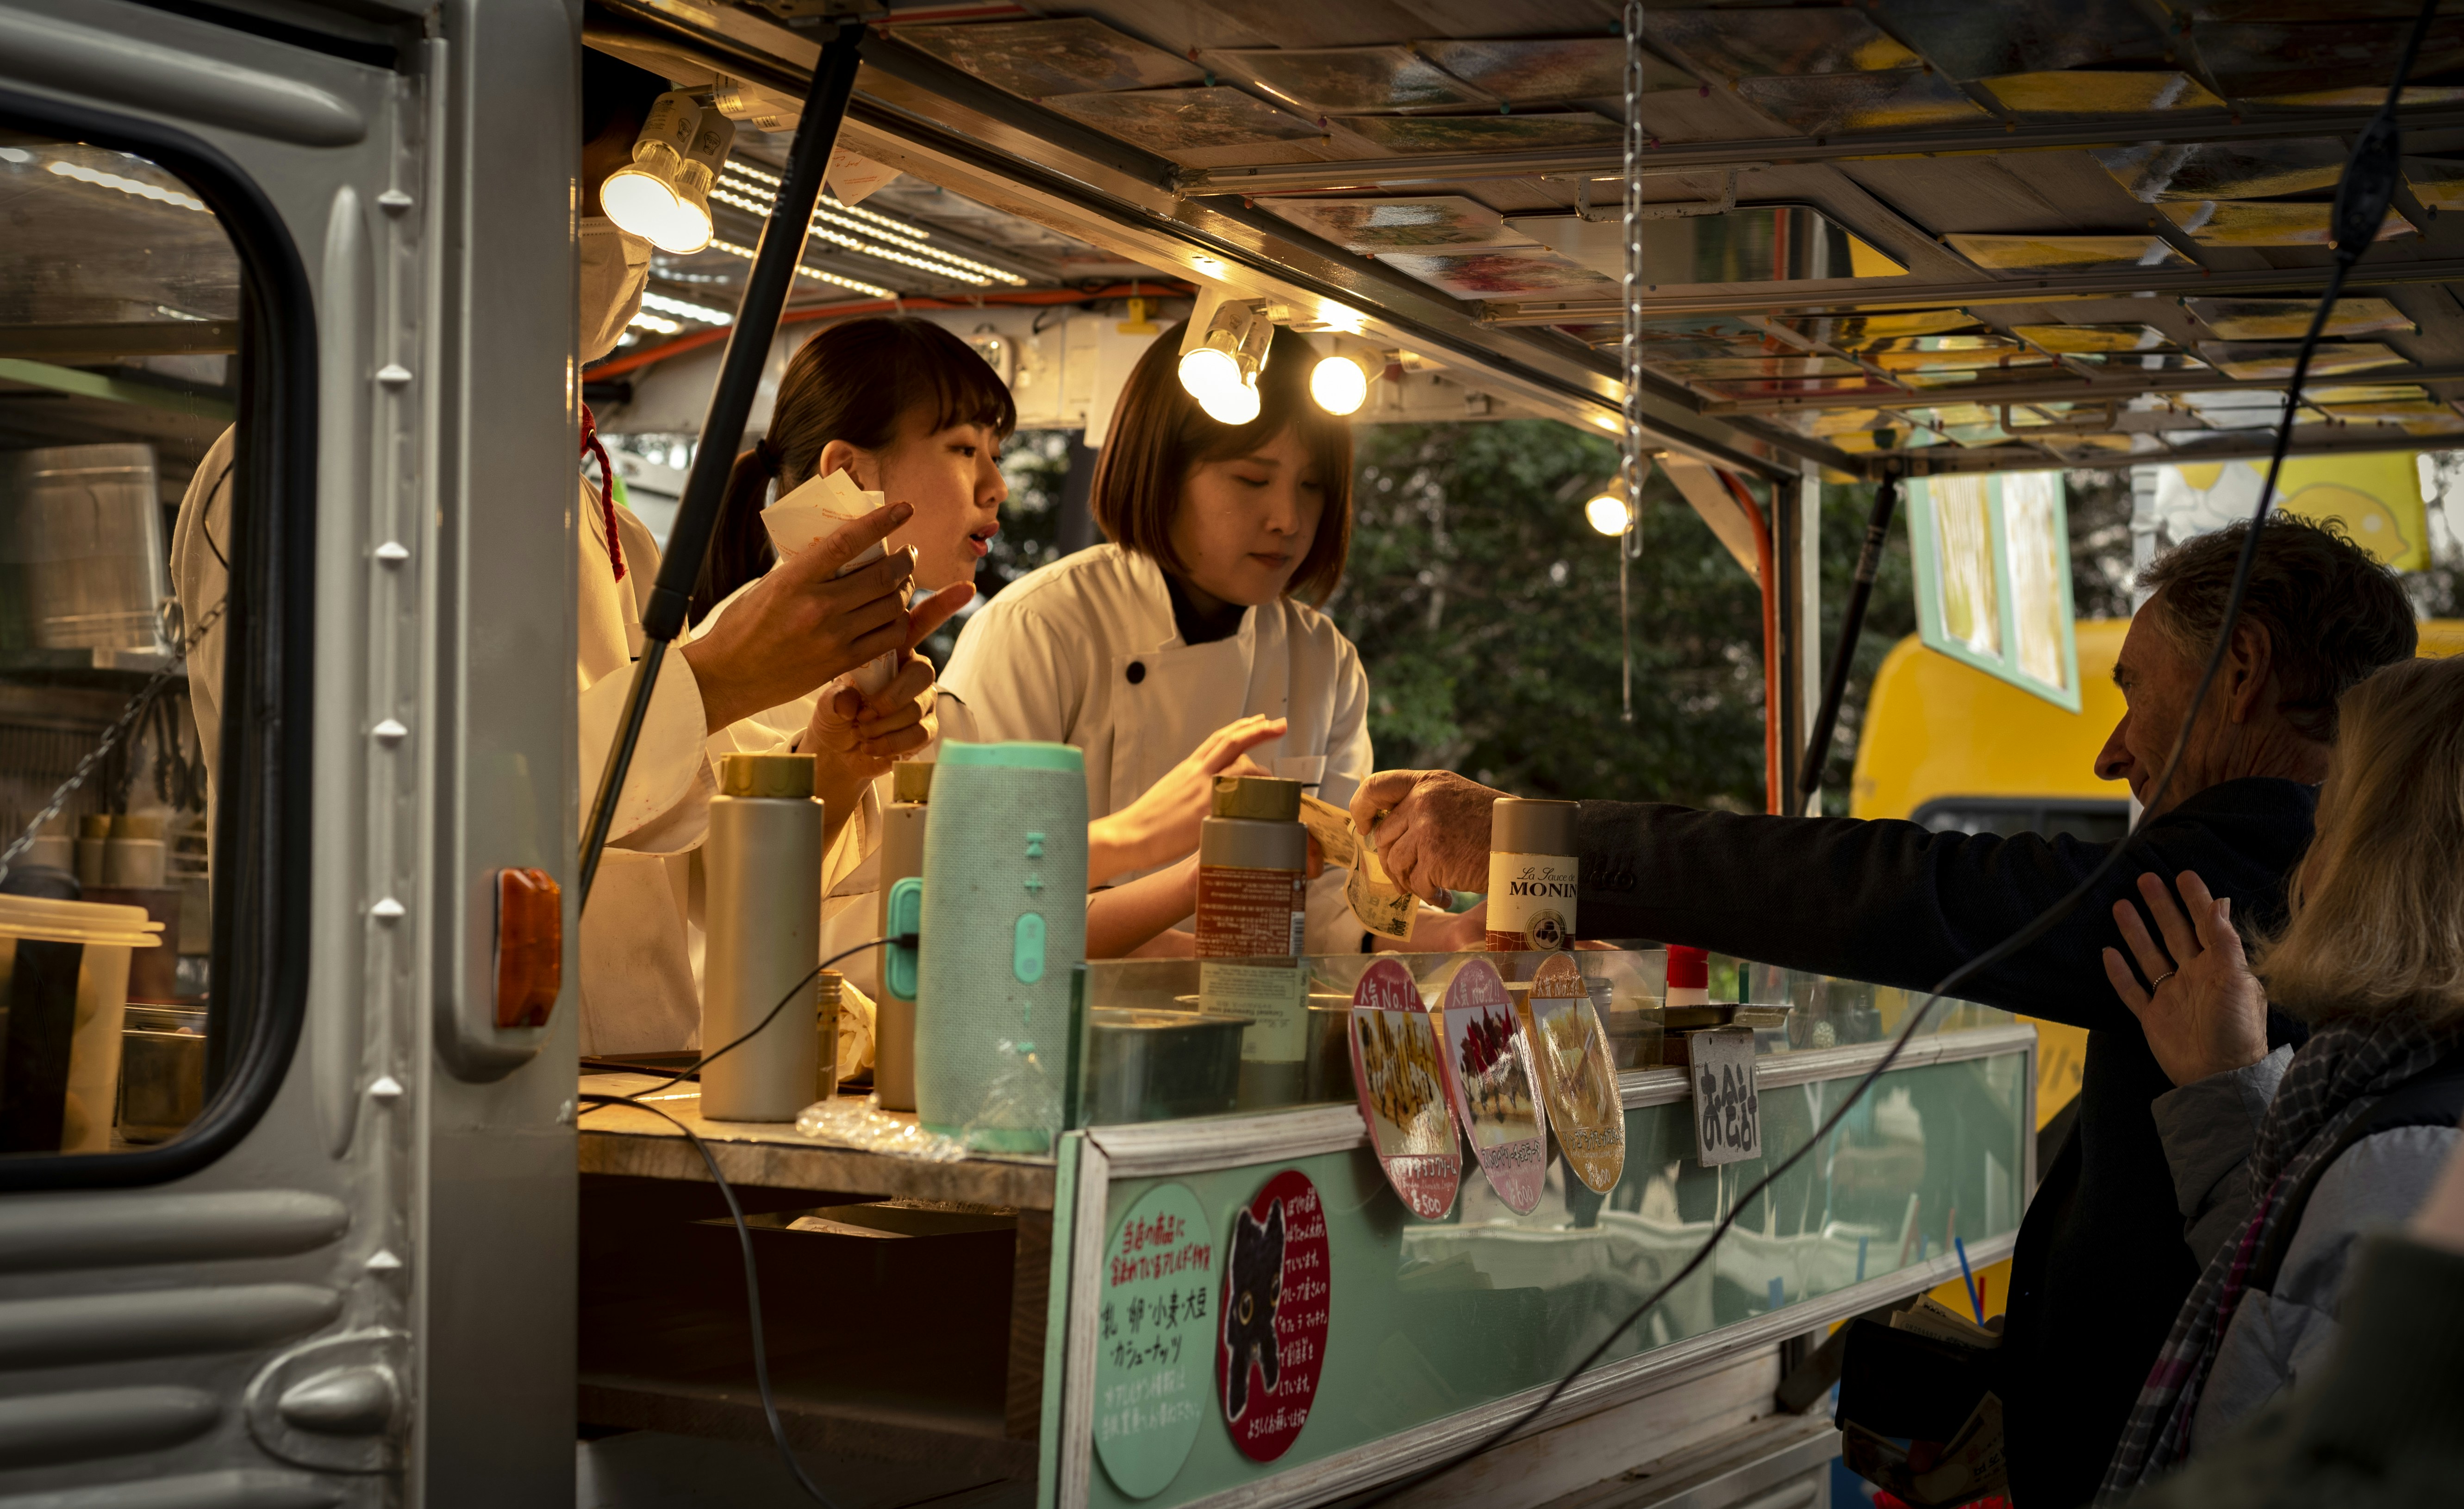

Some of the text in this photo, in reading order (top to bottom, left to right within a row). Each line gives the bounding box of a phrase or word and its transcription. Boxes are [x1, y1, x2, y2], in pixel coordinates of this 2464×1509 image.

[1516, 867, 1575, 882] La Sauce de
[1509, 881, 1577, 898] MONIN
[1393, 919, 1407, 936] 1000
